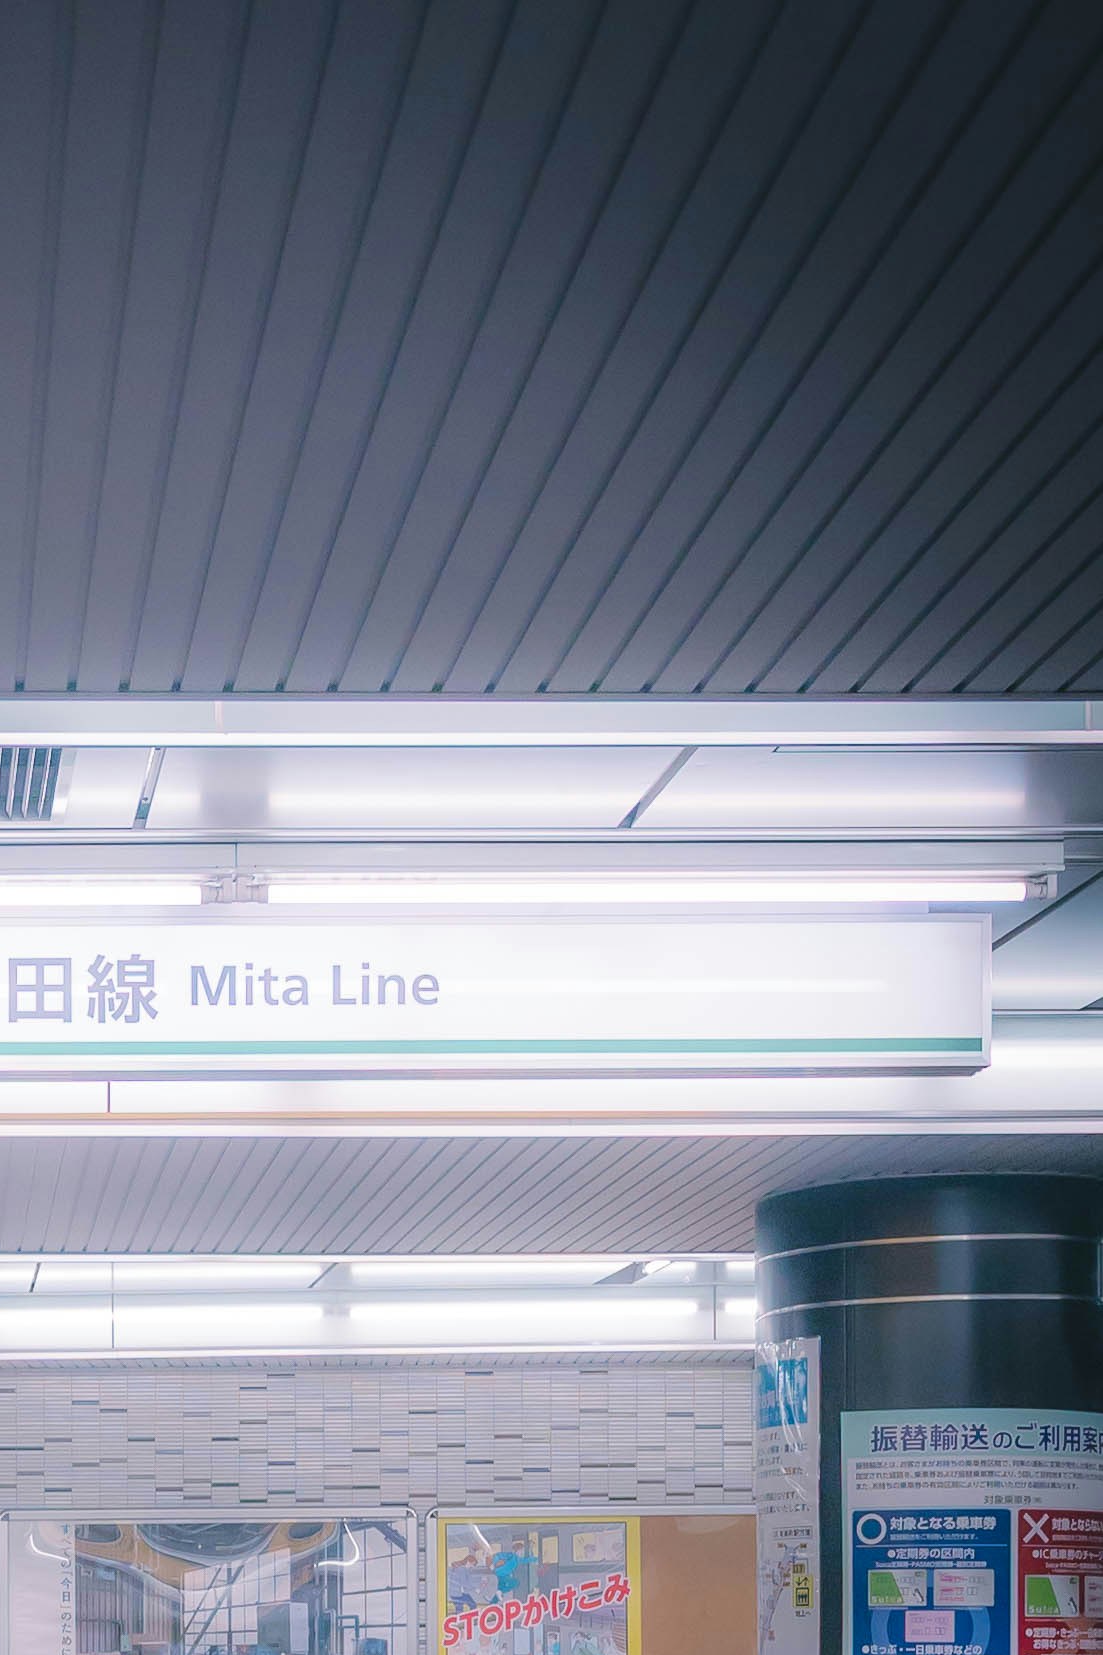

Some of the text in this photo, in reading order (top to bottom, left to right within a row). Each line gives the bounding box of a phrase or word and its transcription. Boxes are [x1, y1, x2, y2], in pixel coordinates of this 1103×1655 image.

[190, 963, 440, 1007] Mita Line
[442, 1573, 631, 1647] STOPかけこみ
